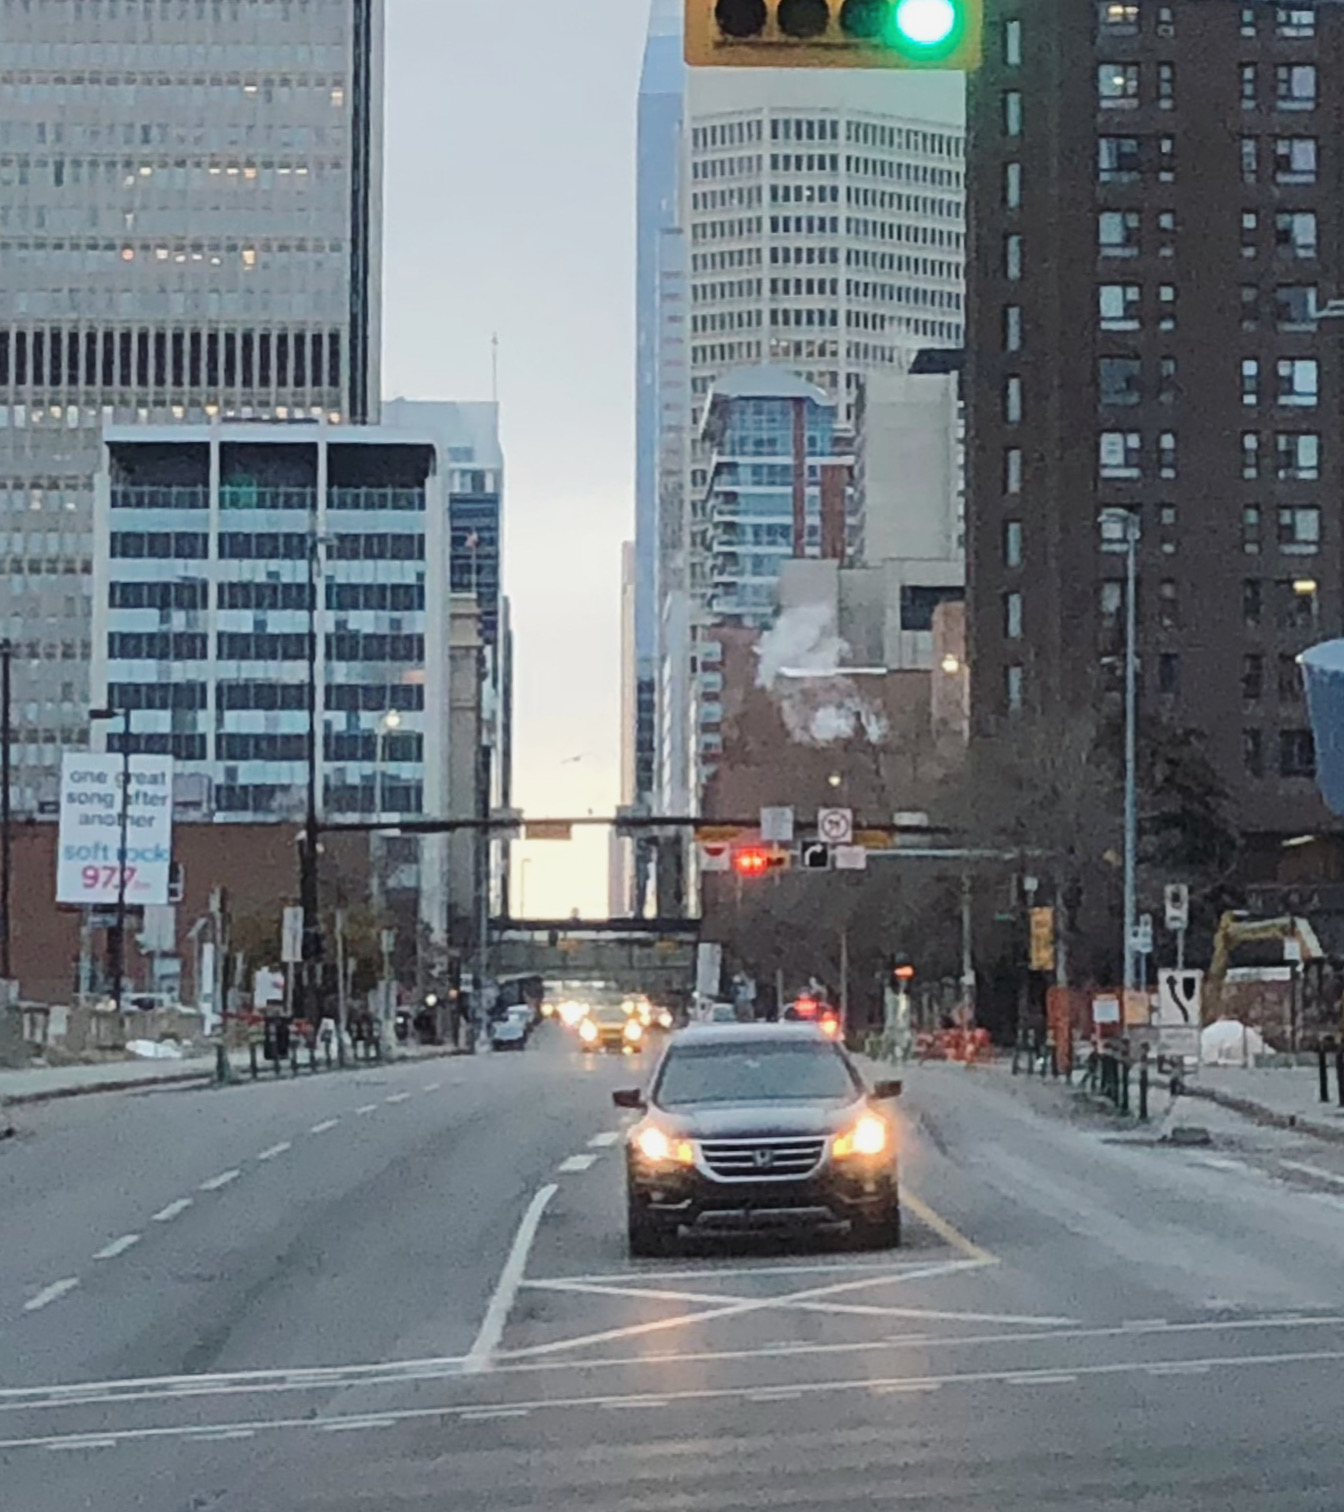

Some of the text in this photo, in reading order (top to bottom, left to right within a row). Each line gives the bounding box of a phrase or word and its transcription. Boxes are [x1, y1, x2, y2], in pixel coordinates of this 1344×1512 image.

[69, 770, 107, 783] one
[66, 792, 115, 809] song
[64, 841, 108, 861] soft
